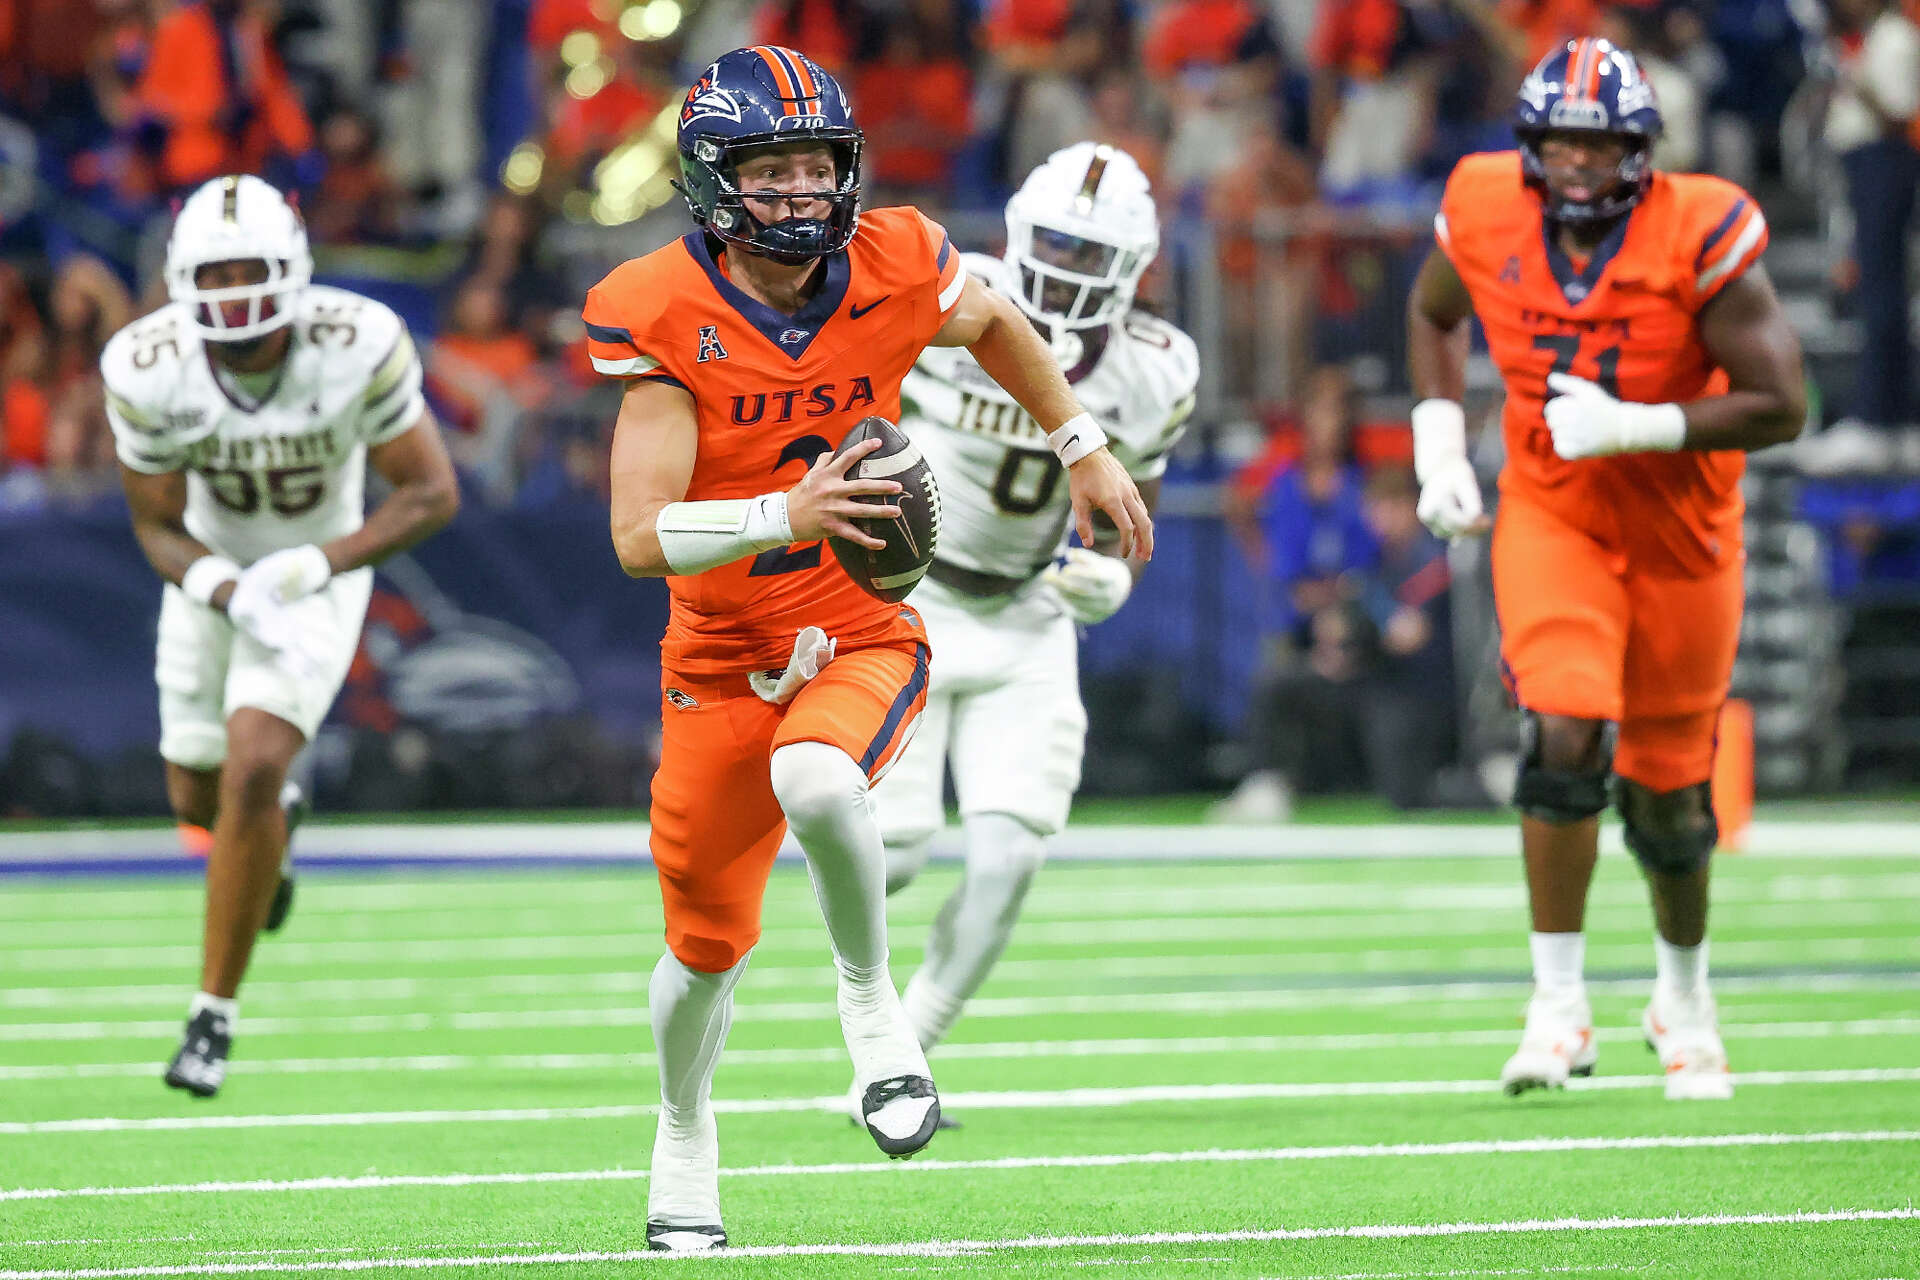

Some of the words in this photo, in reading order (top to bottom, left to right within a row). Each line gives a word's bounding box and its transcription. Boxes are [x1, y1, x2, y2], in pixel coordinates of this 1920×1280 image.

[696, 325, 728, 363] A
[1532, 333, 1624, 403] 71
[729, 375, 877, 427] UTSA
[996, 448, 1067, 515] 0
